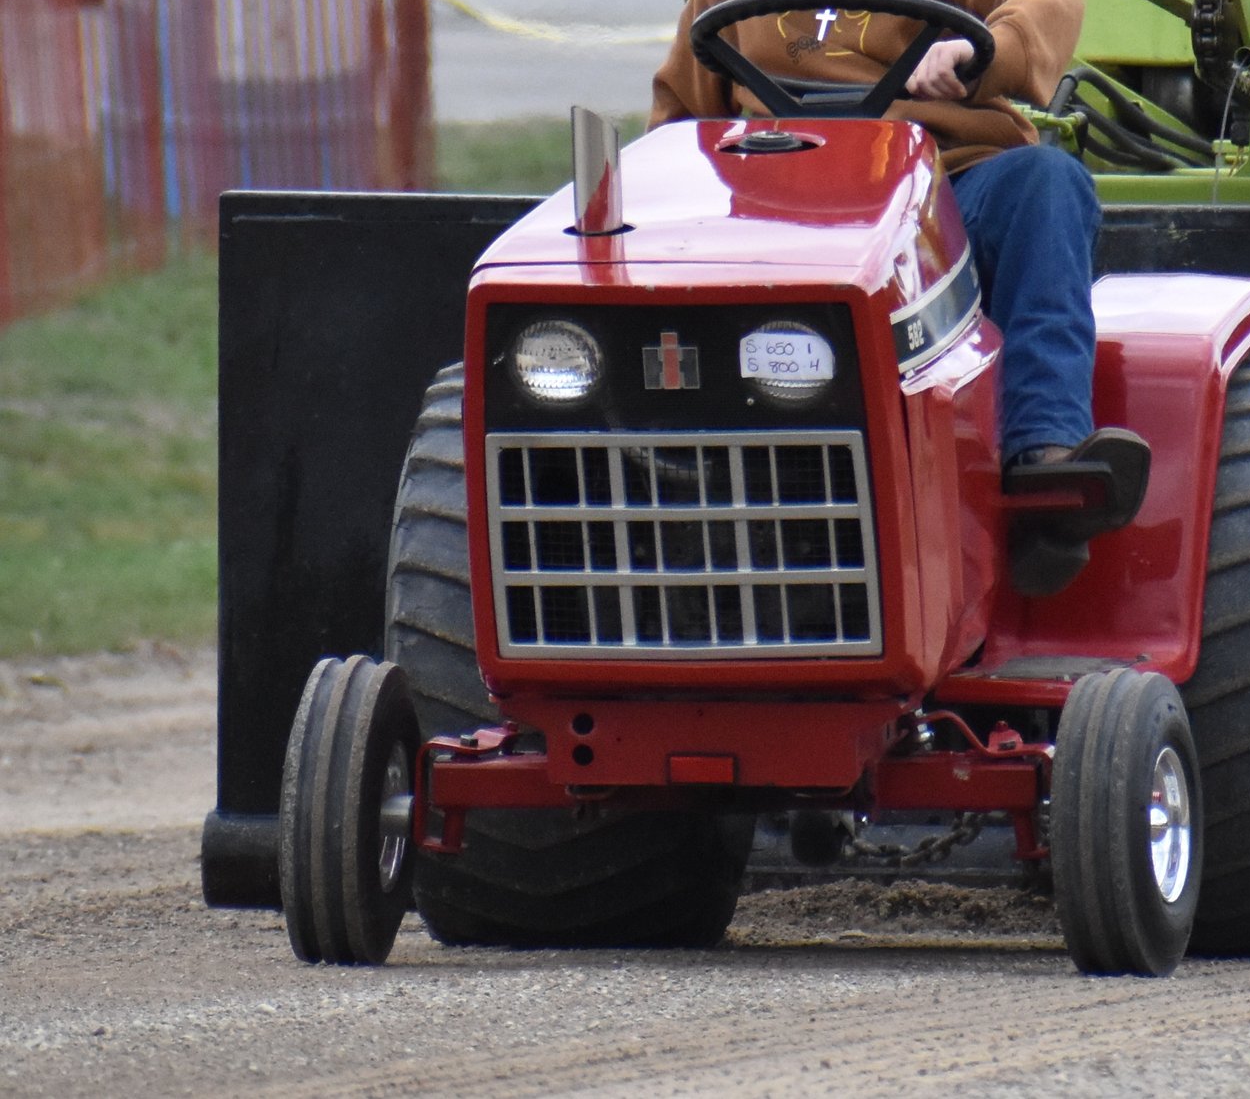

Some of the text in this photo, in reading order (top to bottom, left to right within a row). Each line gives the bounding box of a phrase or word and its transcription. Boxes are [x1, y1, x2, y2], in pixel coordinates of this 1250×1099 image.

[907, 319, 925, 351] 582
[766, 342, 795, 356] 650
[768, 361, 799, 374] 800
[810, 358, 820, 372] 4
